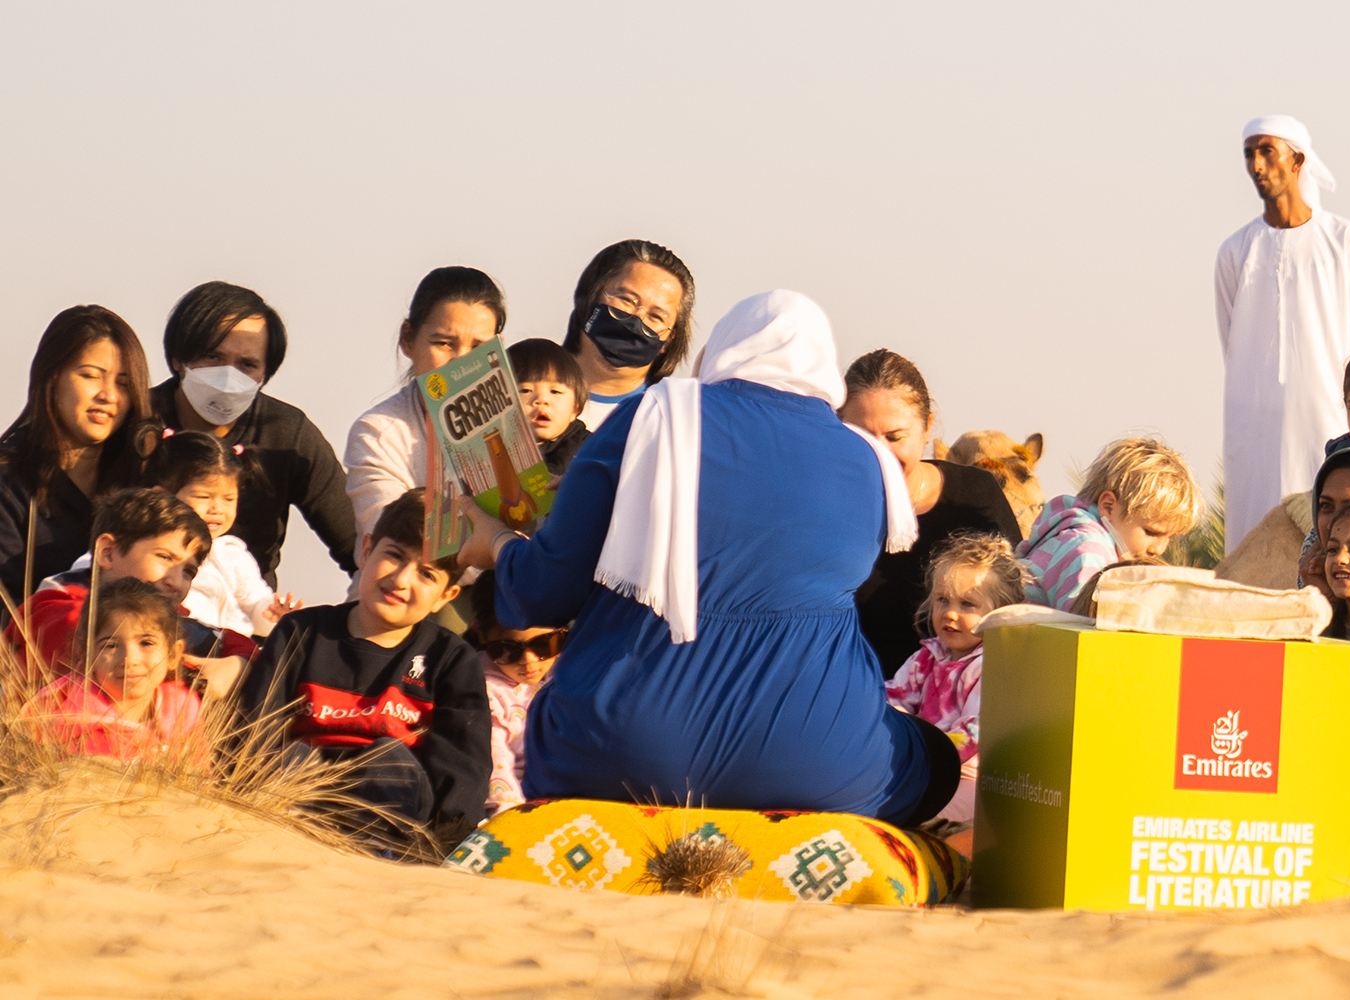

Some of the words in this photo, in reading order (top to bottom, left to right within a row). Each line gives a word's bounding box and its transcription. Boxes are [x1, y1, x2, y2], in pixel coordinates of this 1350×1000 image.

[319, 704, 376, 719] POLO
[1182, 754, 1272, 778] Emirates
[981, 772, 1062, 807] emirateslitfest.com
[1132, 815, 1232, 841] EMIRATES
[1235, 820, 1315, 844] AIRLINE
[1130, 840, 1270, 876] FESTIVAL
[1273, 845, 1313, 877] OF
[1128, 874, 1312, 911] LITERATURE
